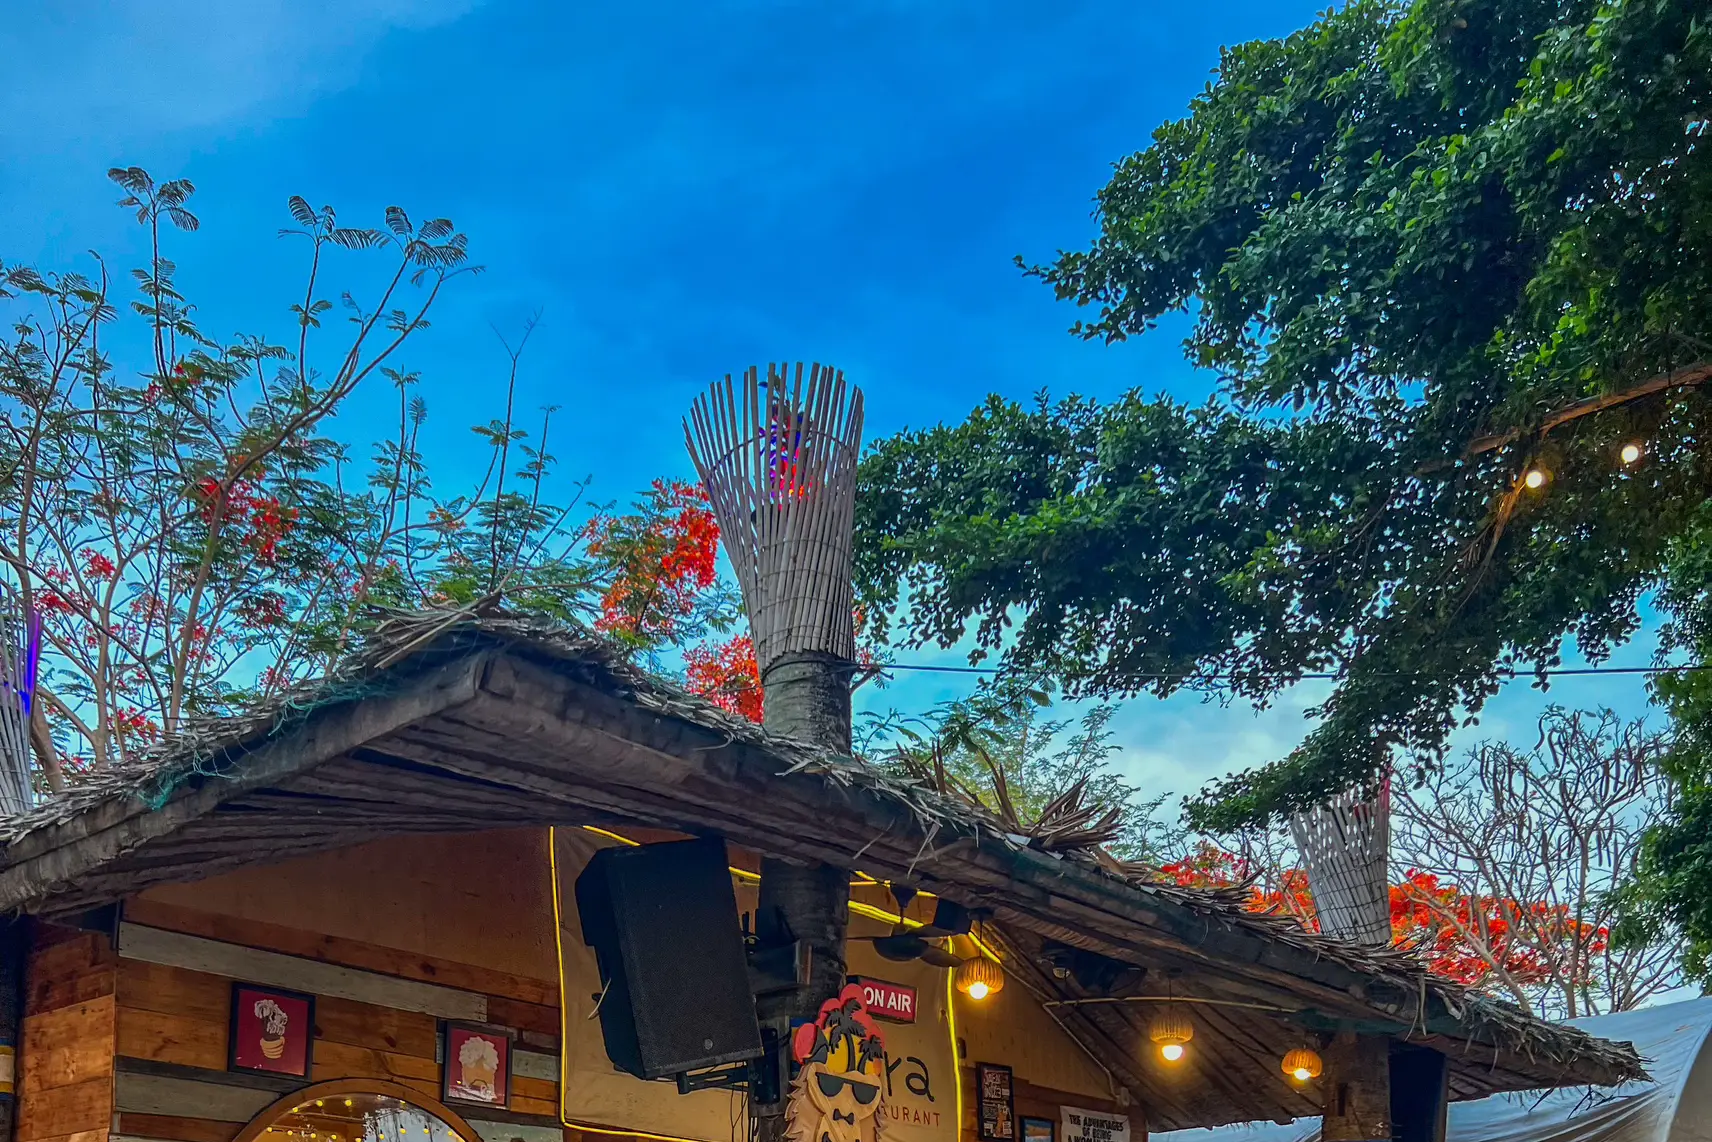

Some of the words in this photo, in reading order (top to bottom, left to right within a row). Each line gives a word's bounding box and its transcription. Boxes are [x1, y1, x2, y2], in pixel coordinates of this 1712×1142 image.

[864, 986, 885, 1008] ON
[886, 991, 912, 1014] AIR
[884, 1050, 935, 1102] ra
